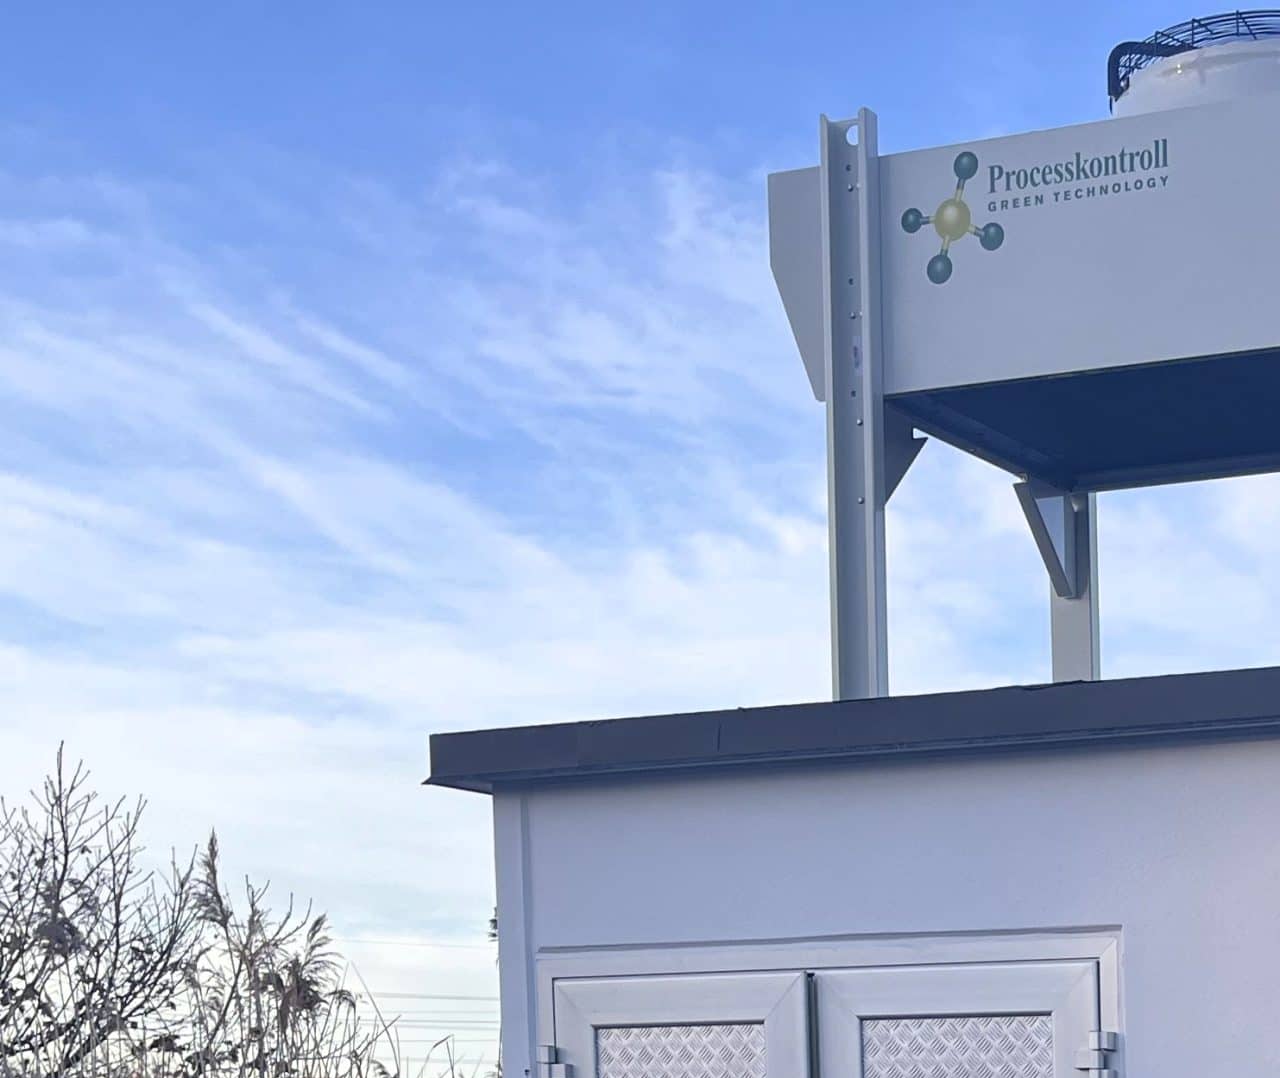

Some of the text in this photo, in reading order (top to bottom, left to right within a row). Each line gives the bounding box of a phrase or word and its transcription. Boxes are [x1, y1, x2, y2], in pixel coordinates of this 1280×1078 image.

[988, 138, 1169, 194] Processkontroll
[988, 175, 1170, 212] GREEN TECHNOLOGY
